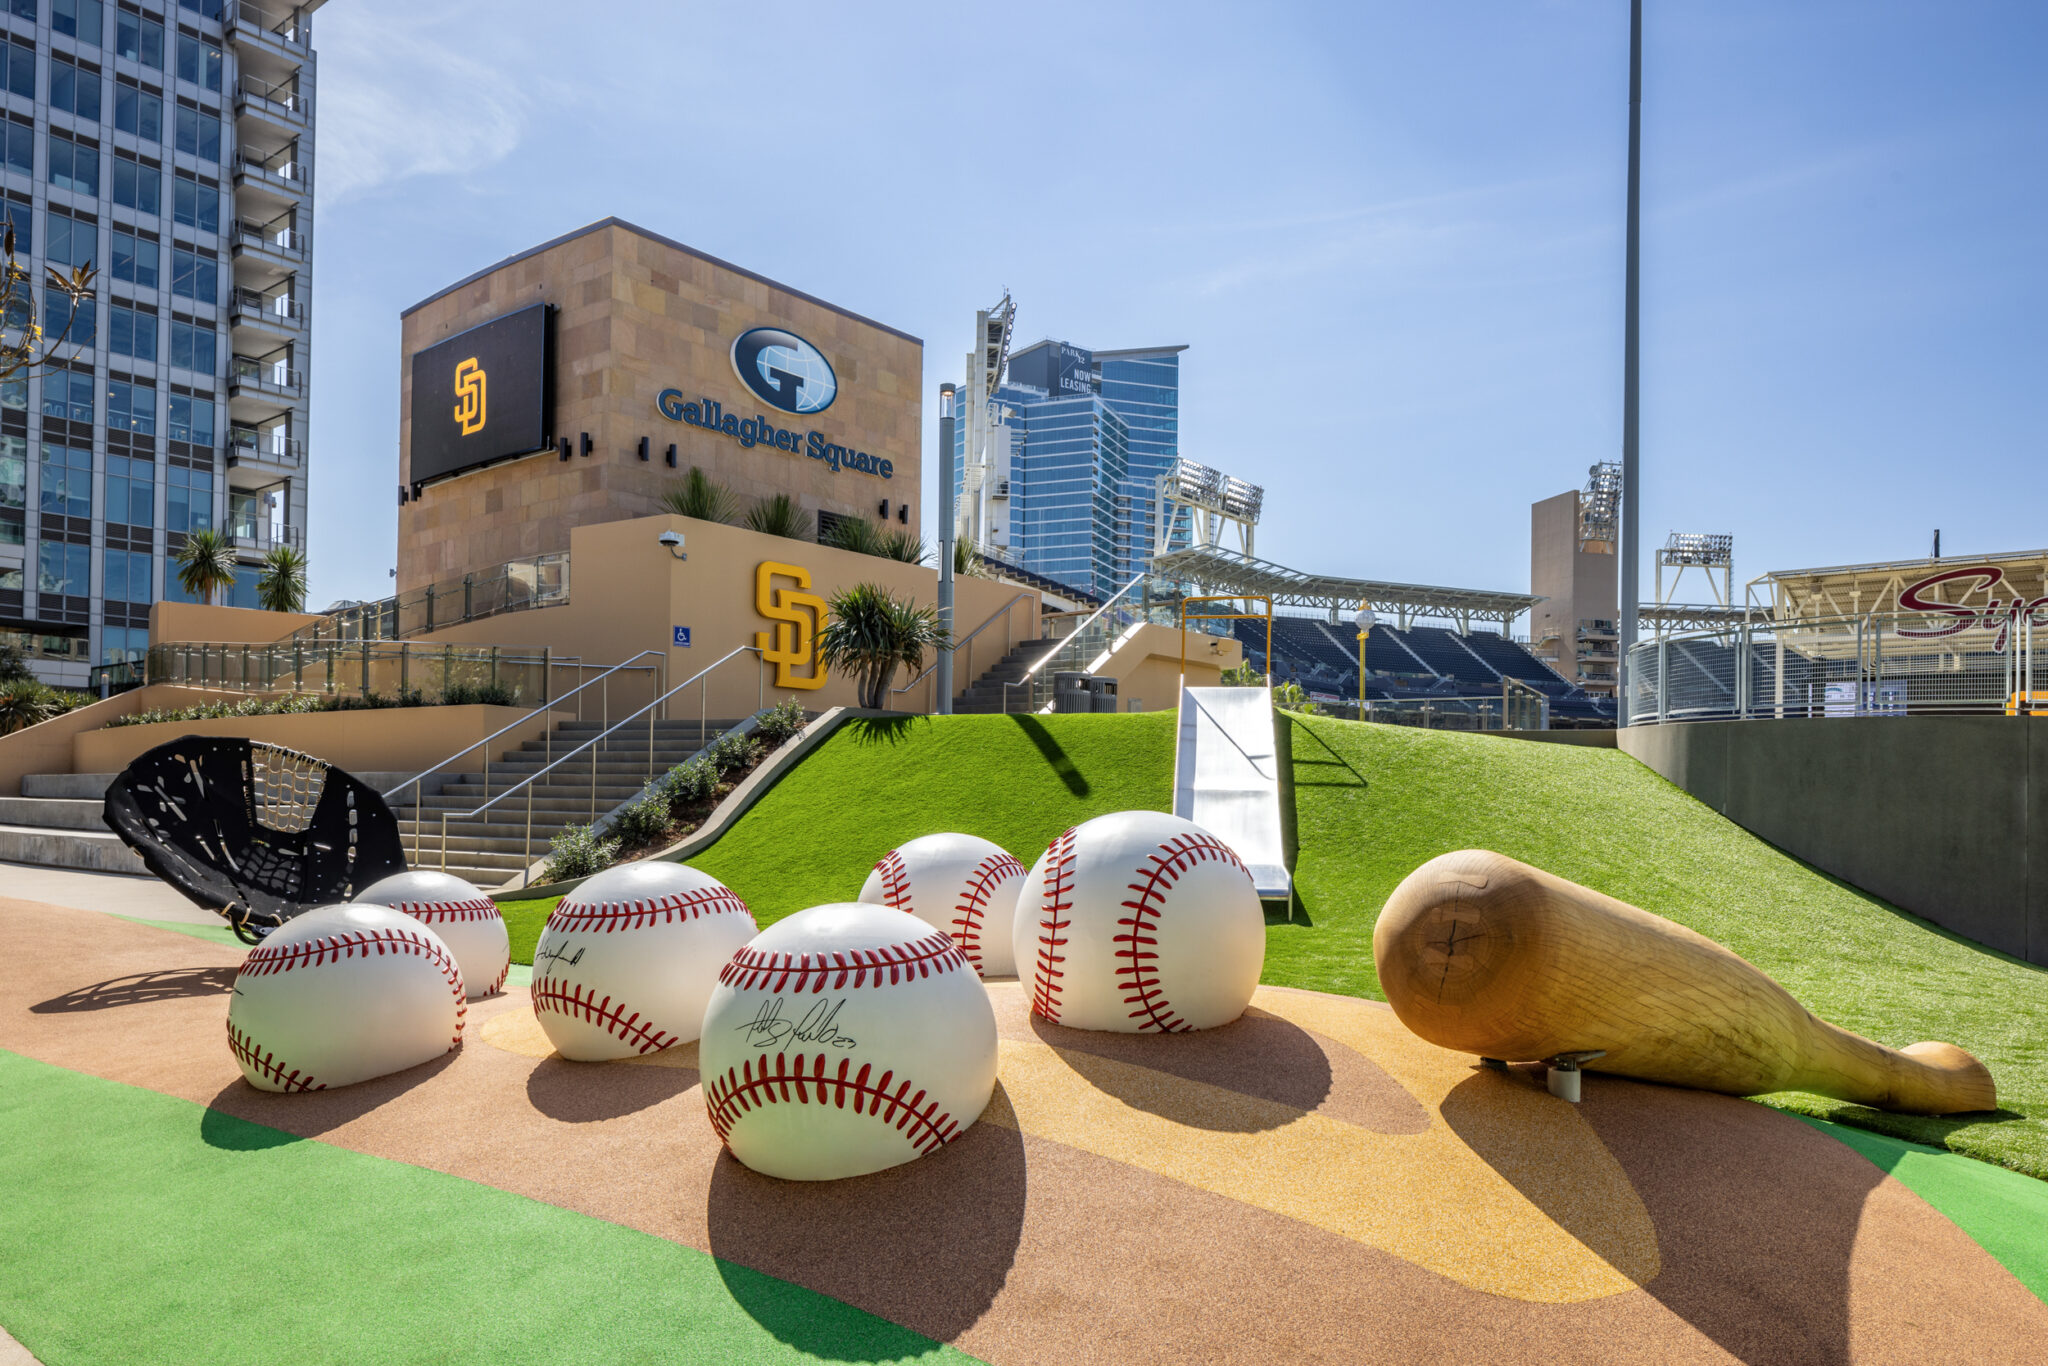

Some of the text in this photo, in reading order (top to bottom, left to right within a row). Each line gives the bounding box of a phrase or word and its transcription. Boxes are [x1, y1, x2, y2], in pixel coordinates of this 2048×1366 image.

[1061, 346, 1080, 358] PARK
[1074, 368, 1091, 382] NOW
[1060, 377, 1091, 394] LEASING
[656, 388, 894, 479] Gallagher Square
